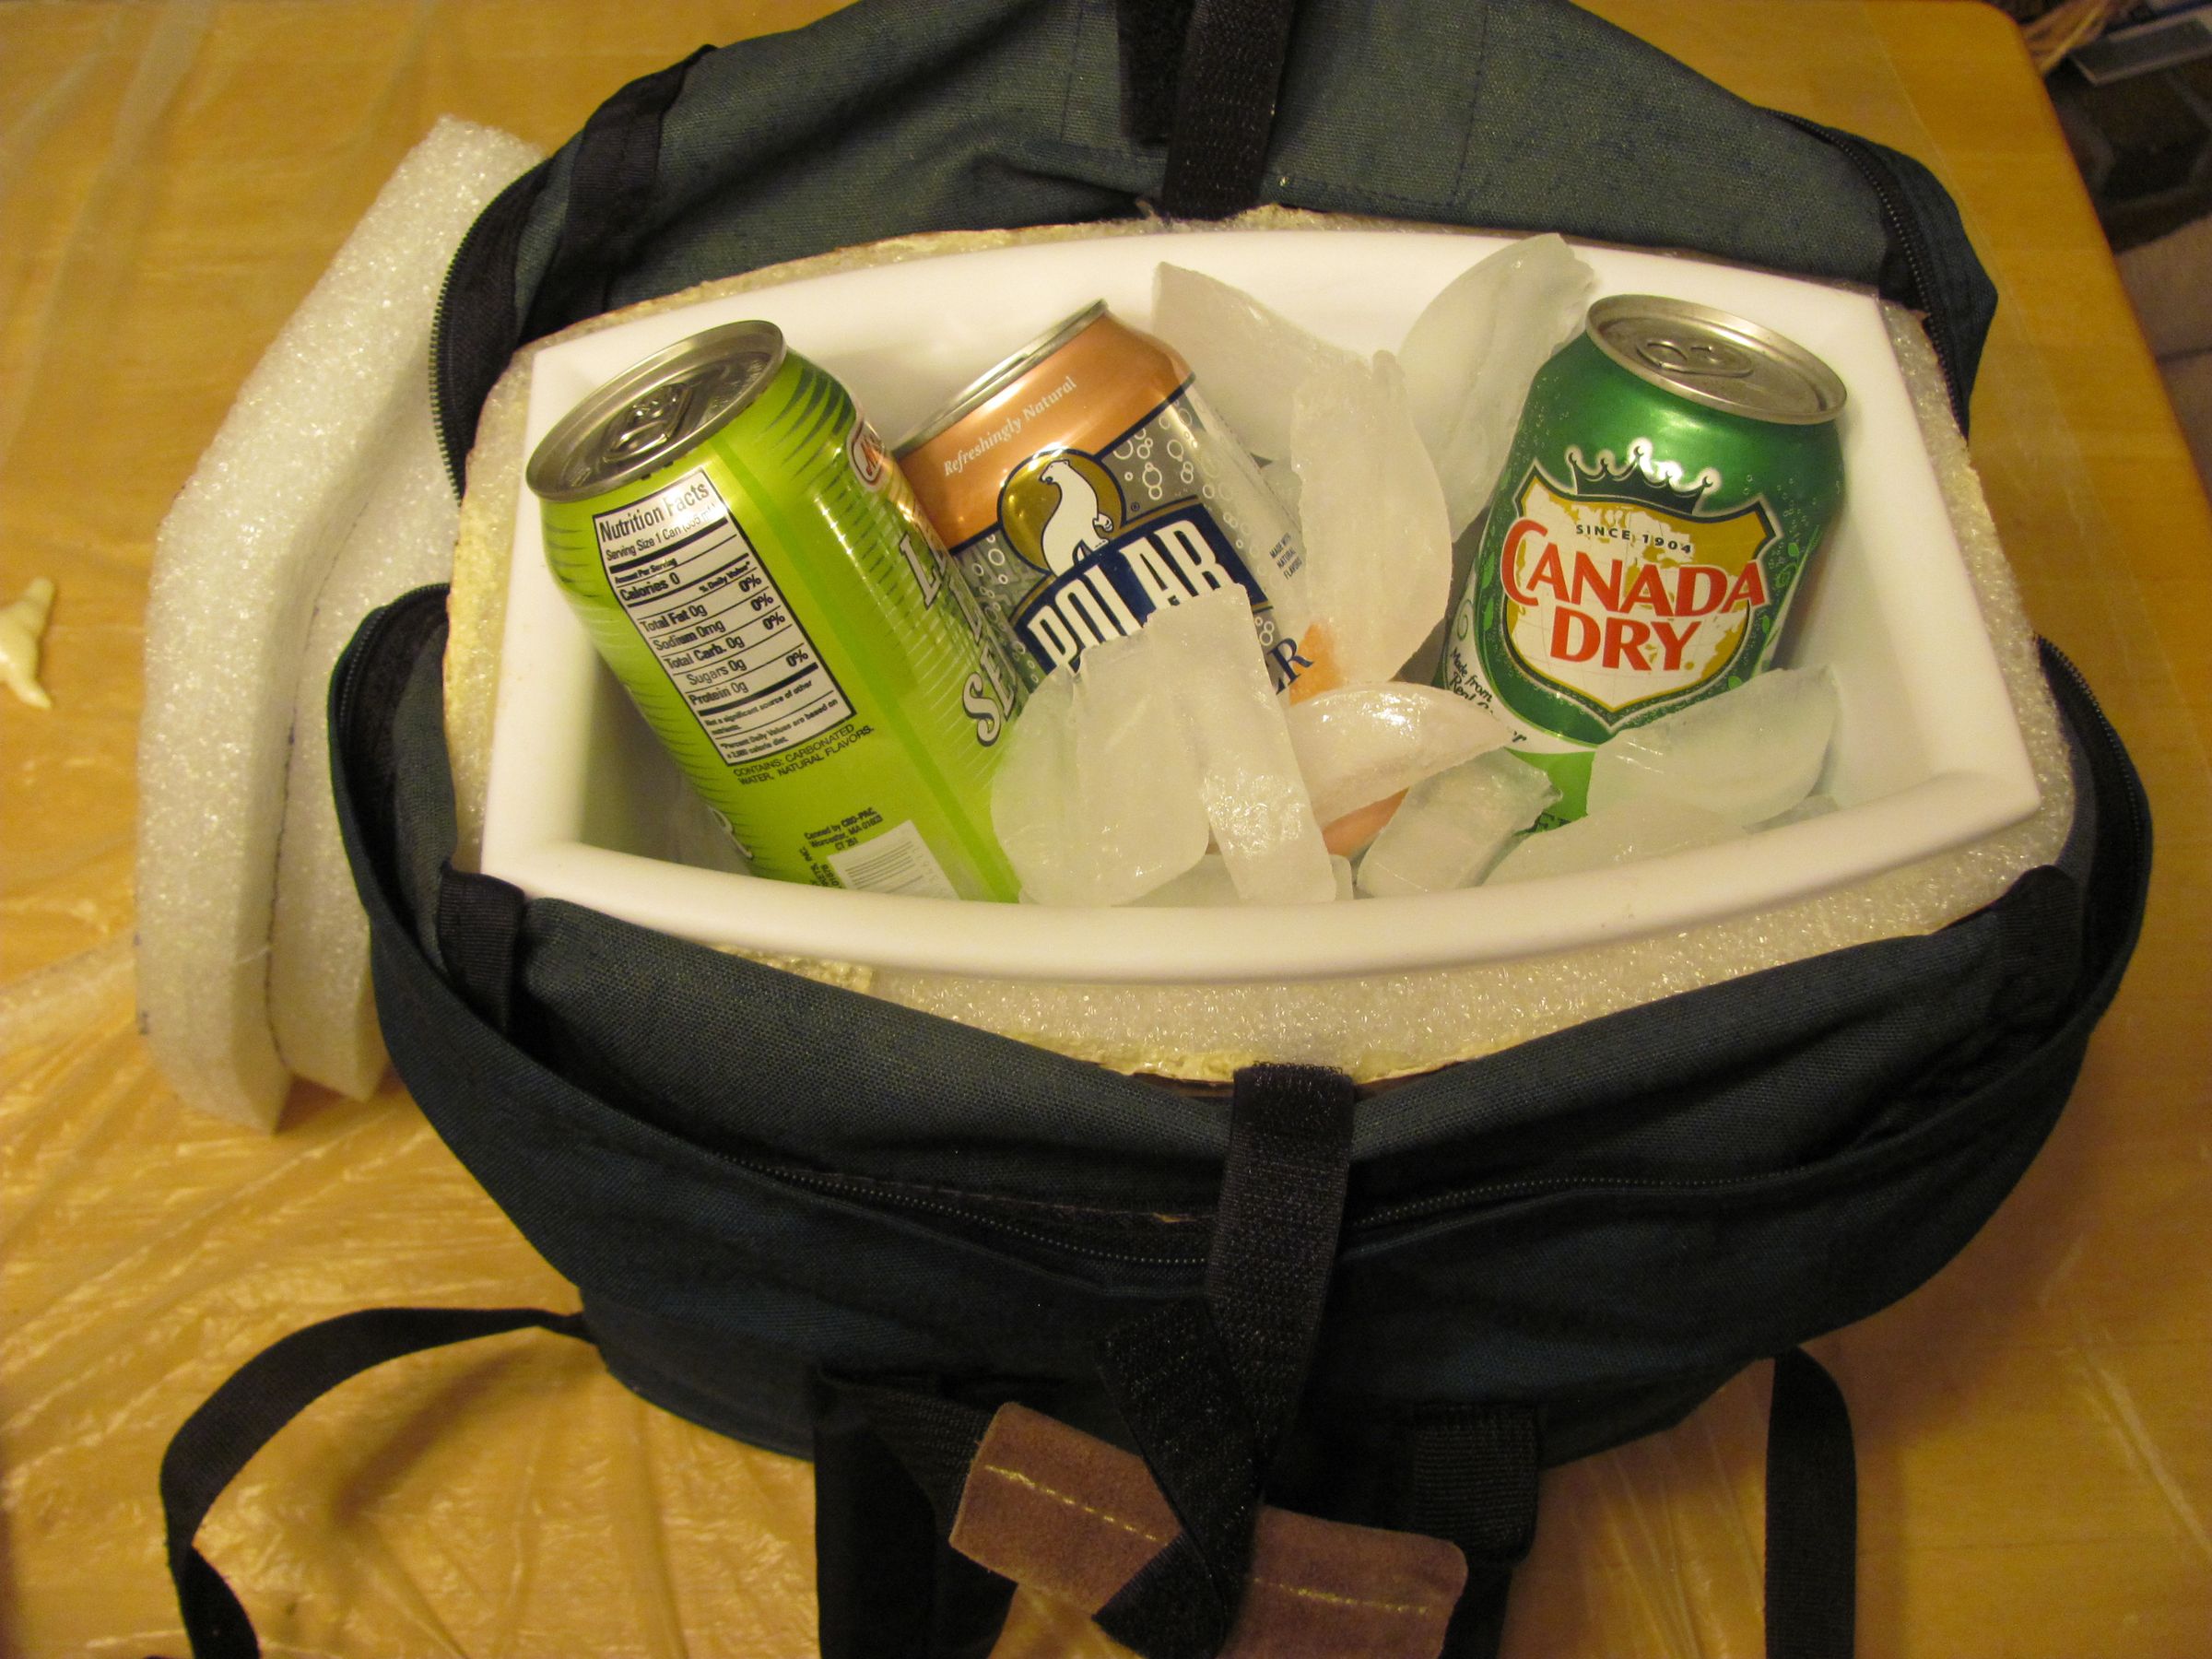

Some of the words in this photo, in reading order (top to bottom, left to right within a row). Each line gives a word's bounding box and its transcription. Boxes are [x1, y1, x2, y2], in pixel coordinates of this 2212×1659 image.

[944, 416, 1022, 477] Refreshingly
[1022, 376, 1077, 421] Natural
[599, 509, 665, 543] Nutrition
[663, 483, 710, 517] Facts
[1575, 524, 1630, 541] SINCE
[1641, 534, 1691, 554] 1904
[606, 544, 637, 561] Serving
[636, 536, 655, 551] Size
[655, 533, 662, 543] 1
[662, 525, 682, 540] Can
[1501, 519, 1766, 618] CANADA
[619, 579, 668, 601] Calories
[669, 571, 680, 584] 0
[640, 616, 670, 632] Total
[670, 608, 691, 624] Fat
[690, 603, 708, 618] 0g
[738, 574, 762, 593] 0%
[653, 630, 698, 651] Sodium
[696, 619, 726, 637] 0mg
[750, 594, 774, 611] 0%
[665, 653, 694, 670] Total
[694, 642, 727, 661] Carb.
[725, 634, 745, 649] 0g
[762, 612, 785, 630] 0%
[1549, 606, 1702, 671] DRY
[687, 664, 729, 686] Sugars
[727, 658, 747, 673] 0g
[689, 686, 731, 706] Protein
[730, 680, 748, 694] 0g
[785, 649, 809, 667] 0%
[759, 696, 783, 711] source
[784, 689, 793, 700] of
[793, 680, 812, 695] other
[1450, 646, 1468, 677] Made
[1466, 675, 1492, 702] from
[805, 704, 828, 720] based
[828, 699, 839, 708] on
[733, 760, 783, 777] CONTAINS:
[785, 724, 855, 762] CARBONATED
[778, 755, 824, 775] NATURAL
[825, 725, 875, 757] FLAVORS.
